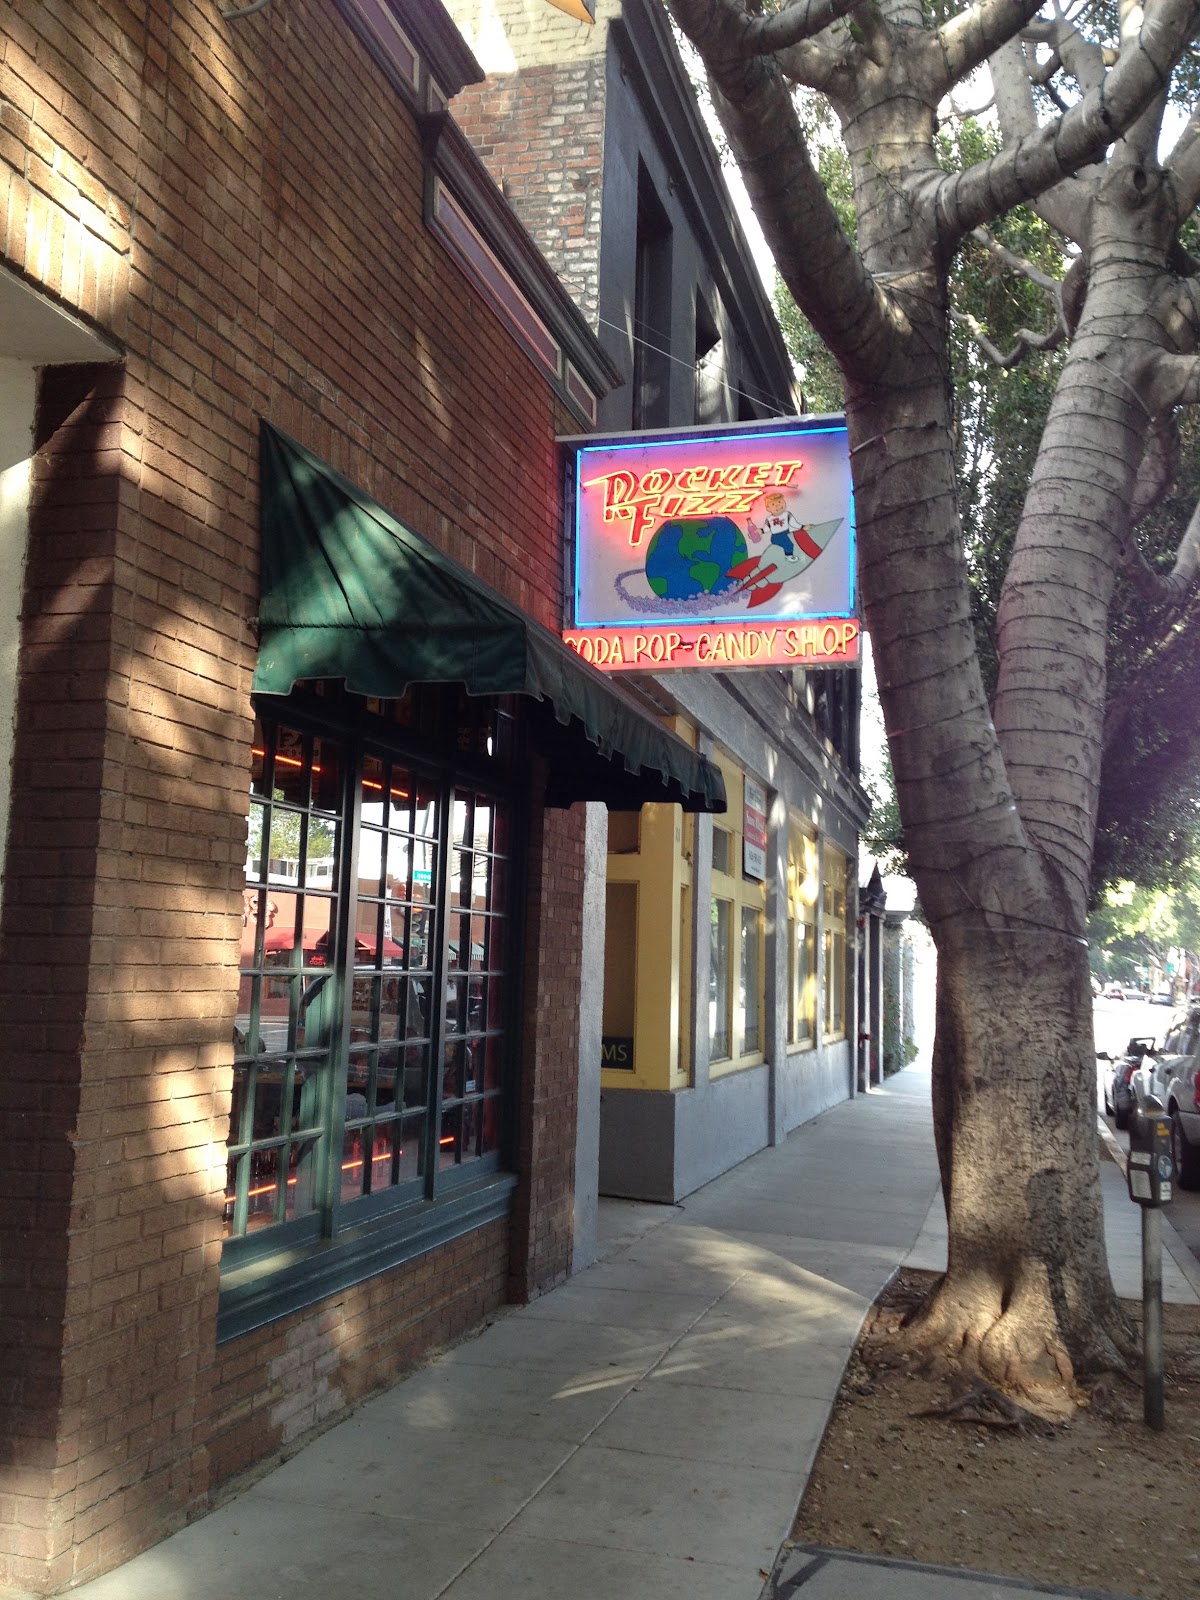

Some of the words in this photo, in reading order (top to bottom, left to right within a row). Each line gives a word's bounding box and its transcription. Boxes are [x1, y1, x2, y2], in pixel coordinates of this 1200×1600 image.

[583, 459, 803, 522] ROCKET
[605, 489, 764, 546] FIZZ
[783, 623, 857, 657] SHOP
